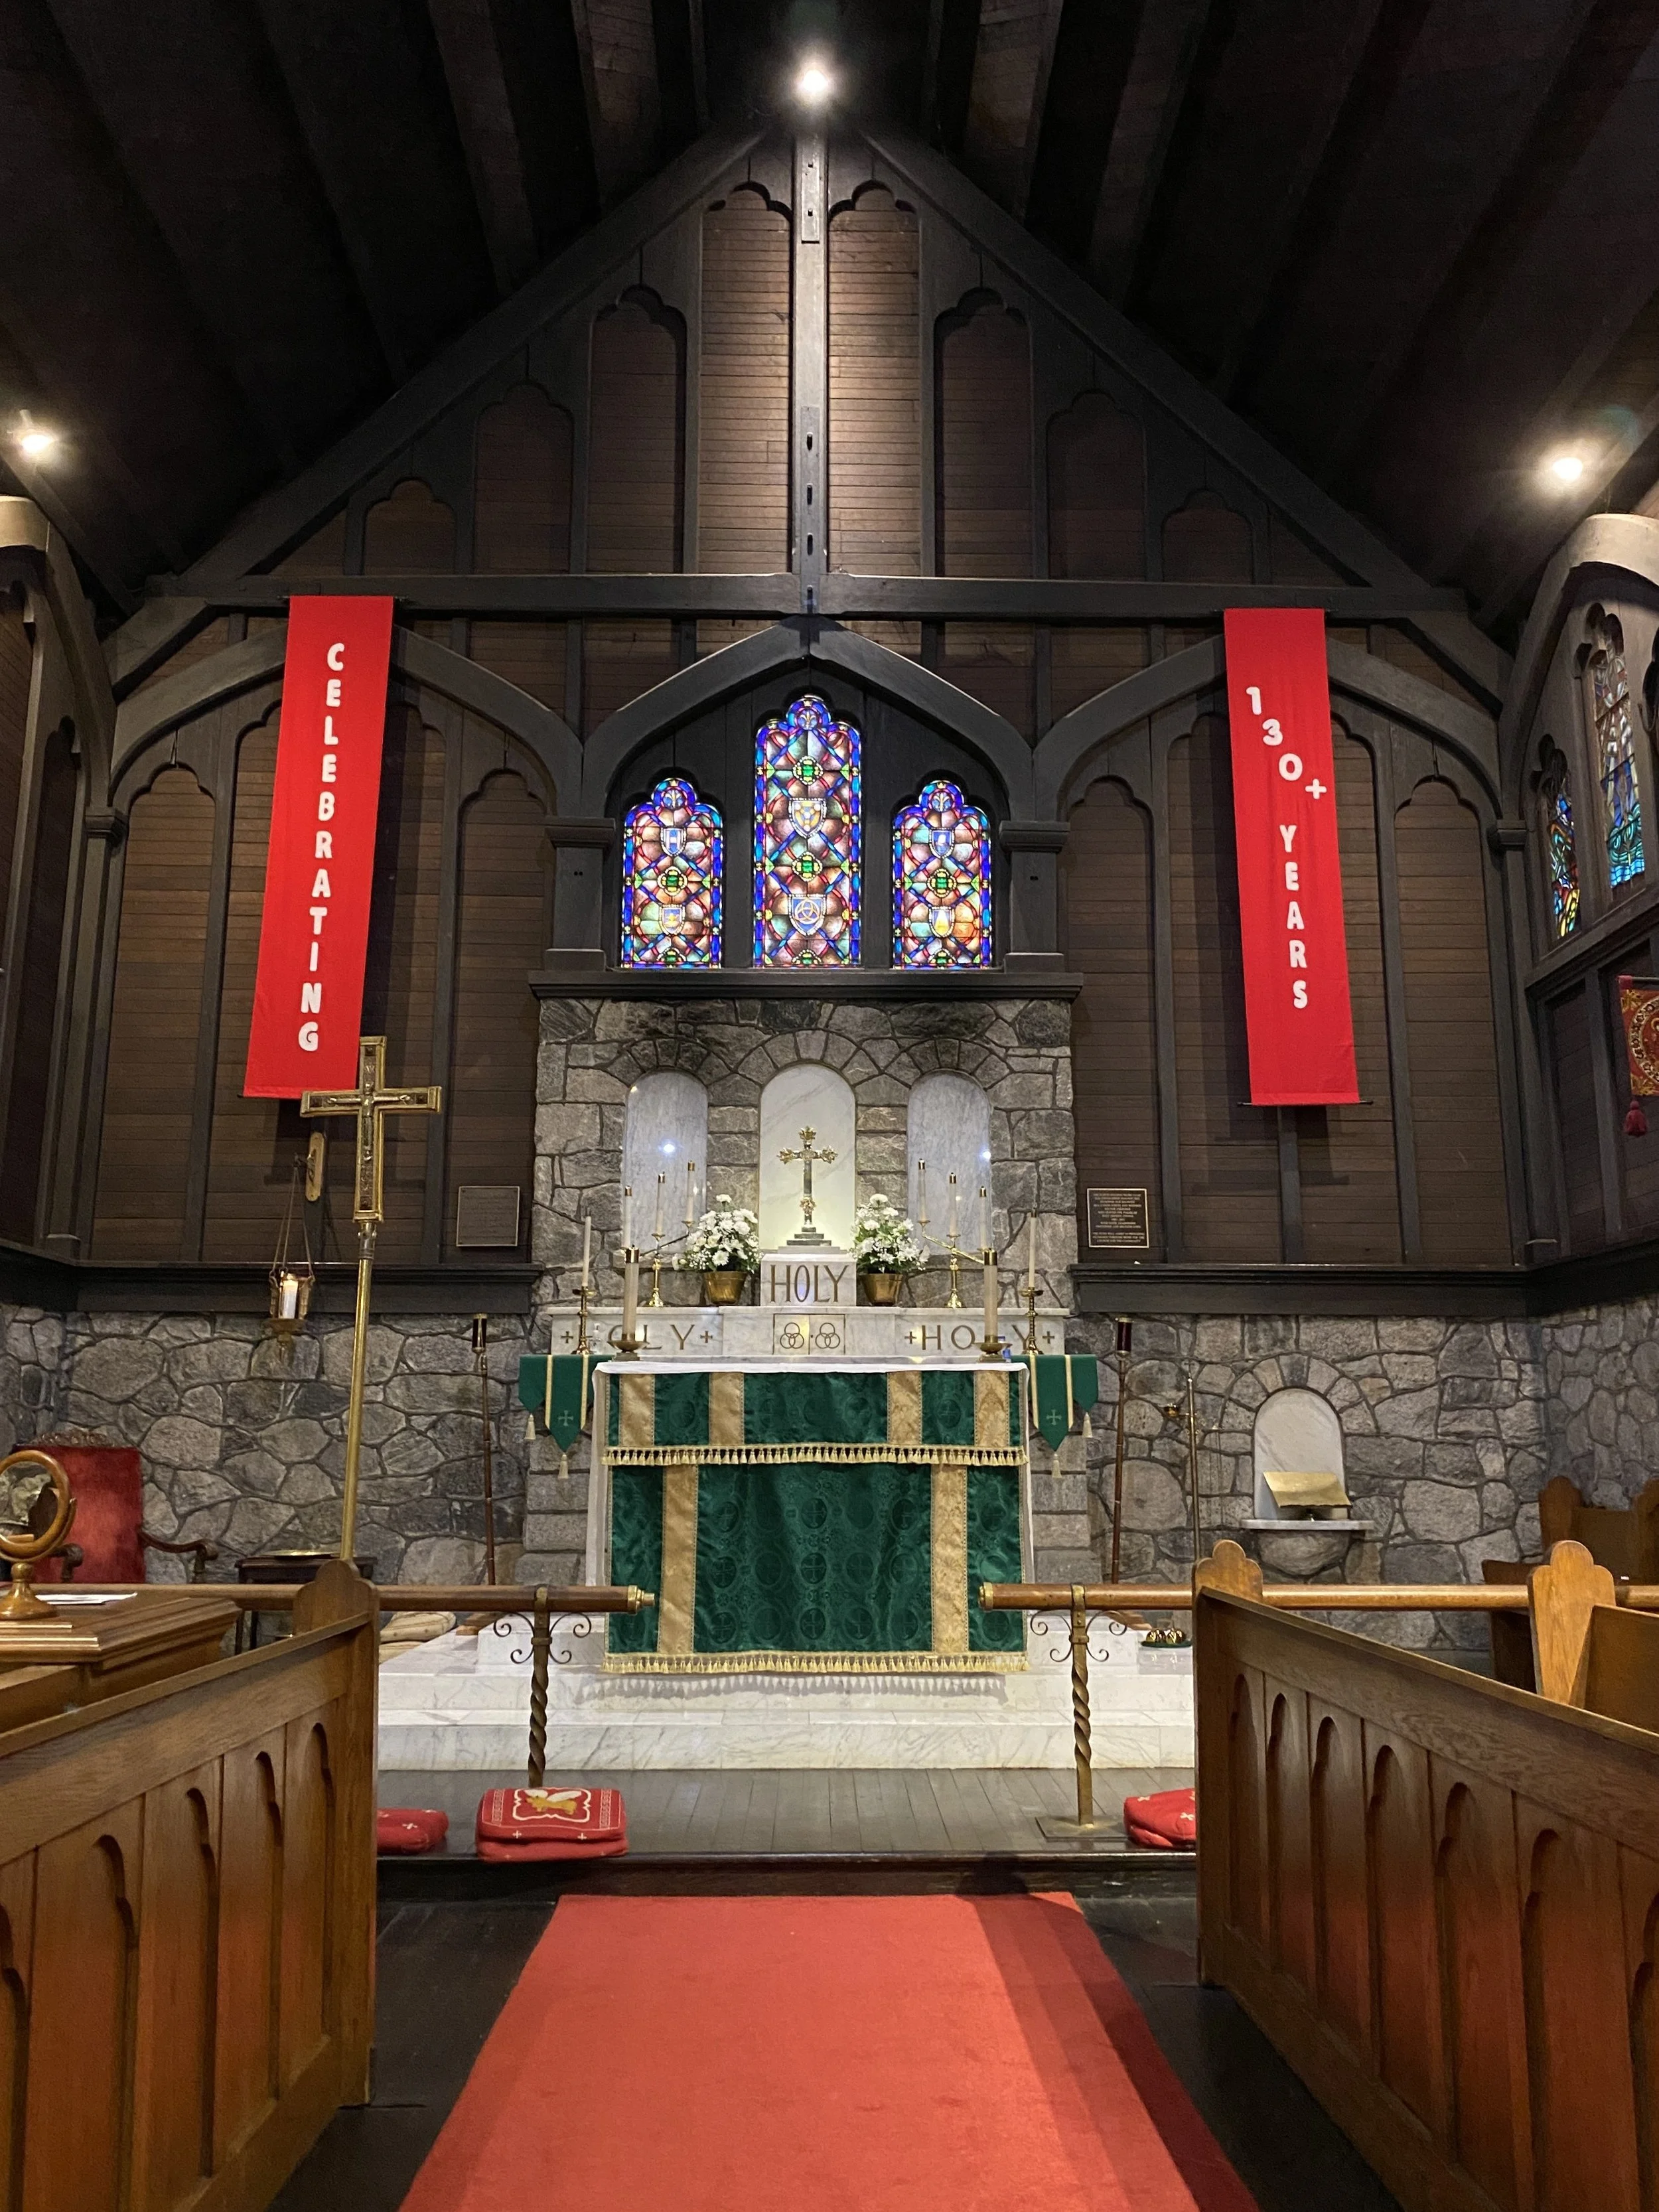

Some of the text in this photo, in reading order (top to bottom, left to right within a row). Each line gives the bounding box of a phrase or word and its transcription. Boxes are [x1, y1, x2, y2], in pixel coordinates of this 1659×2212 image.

[298, 642, 345, 1053] CELEBRATING
[1245, 686, 1327, 1009] 130+ YEARS
[770, 1264, 849, 1303] HOLY
[921, 1325, 1031, 1351] HOY
